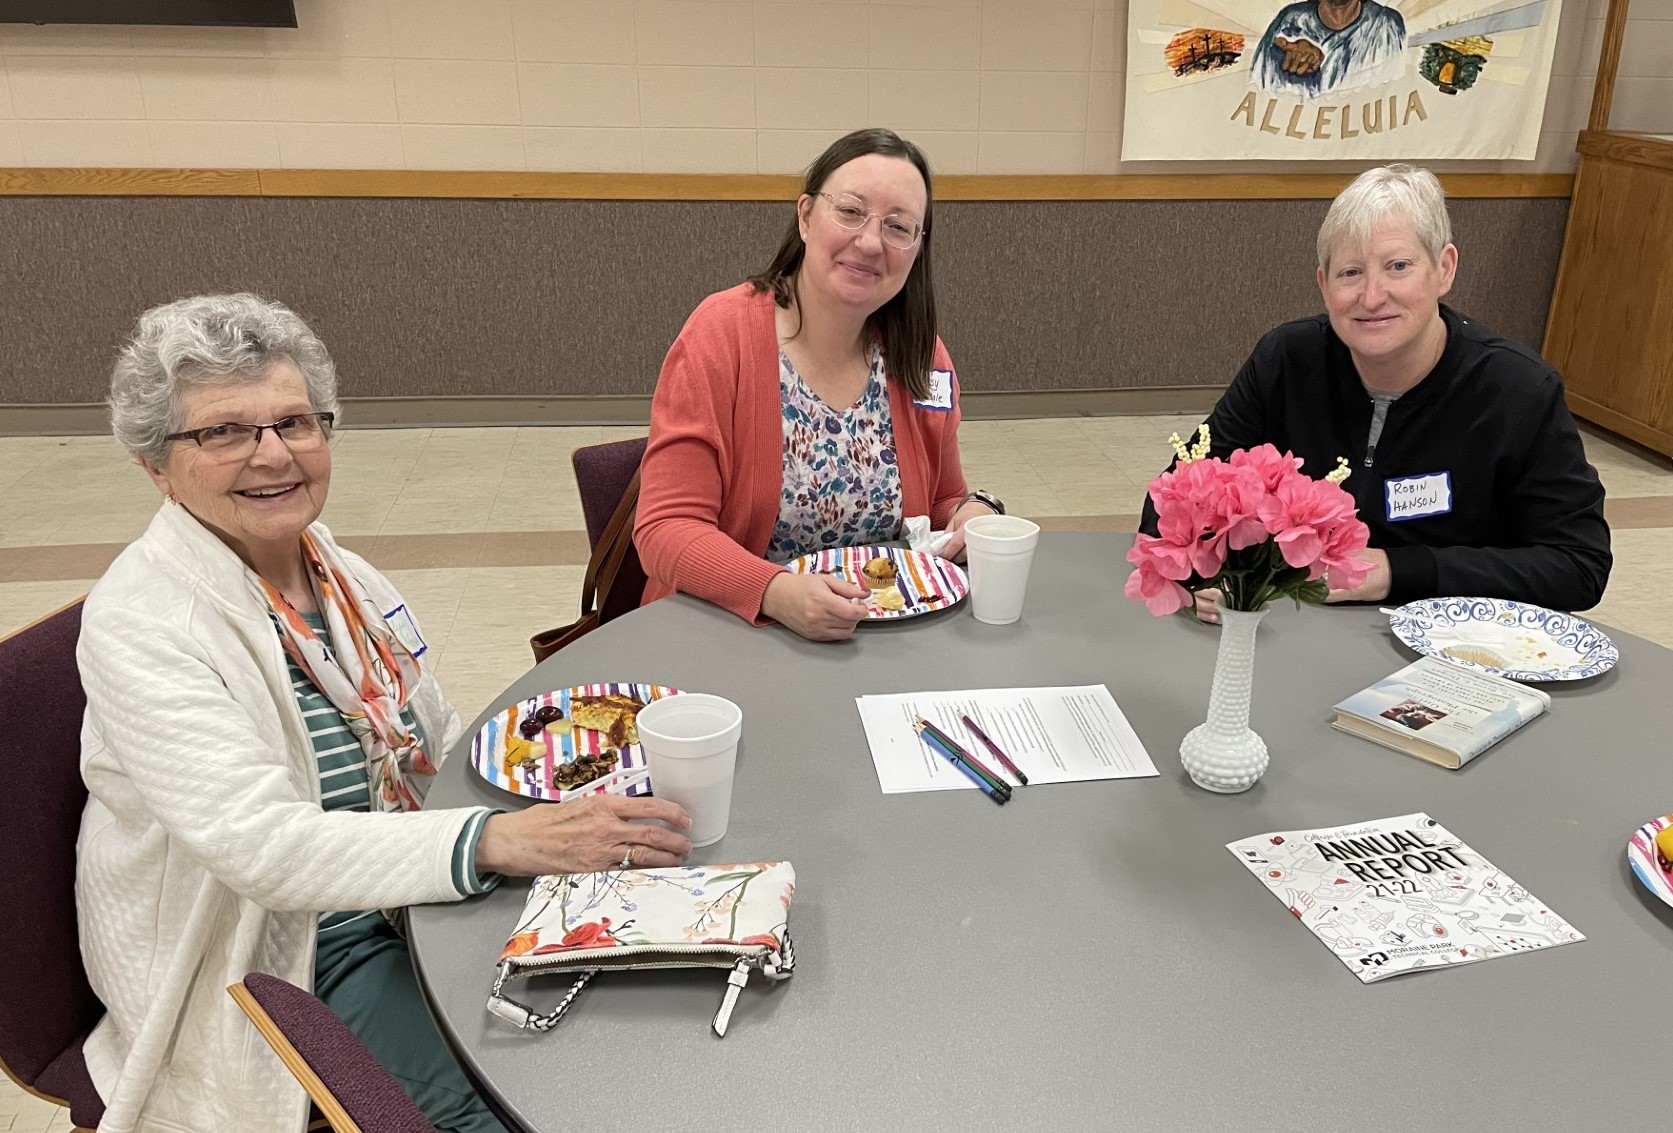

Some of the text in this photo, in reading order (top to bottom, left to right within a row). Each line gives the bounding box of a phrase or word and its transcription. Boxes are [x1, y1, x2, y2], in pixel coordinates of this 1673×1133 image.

[1231, 90, 1428, 139] ALLELUIA
[1394, 481, 1427, 495] ROBIN
[1393, 490, 1437, 511] HANSON
[1314, 830, 1436, 862] ANNUAL
[1344, 847, 1468, 882] REPORT
[1366, 879, 1423, 897] 21-22
[1386, 941, 1456, 955] MORAINE PARK
